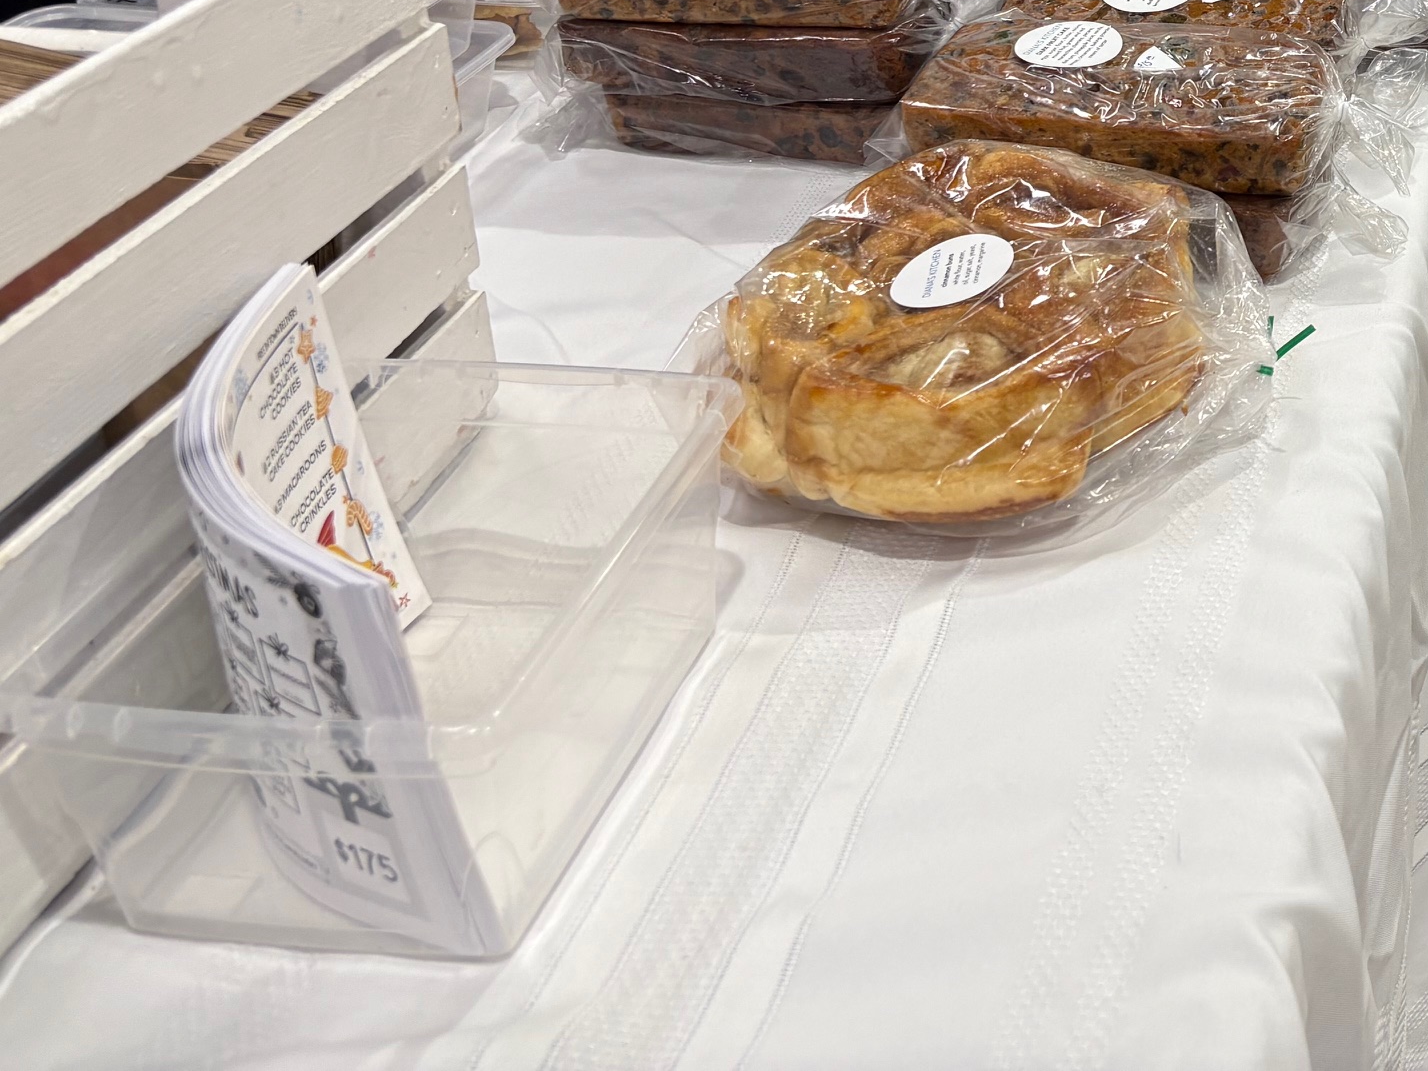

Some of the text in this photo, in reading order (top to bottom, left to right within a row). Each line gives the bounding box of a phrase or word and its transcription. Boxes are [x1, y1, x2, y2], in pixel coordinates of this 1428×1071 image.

[929, 248, 941, 275] KITCHEN
[941, 253, 954, 288] cinnamon buns
[278, 348, 296, 371] HOT
[258, 362, 299, 420] CHOCOLATE
[270, 377, 303, 421] COOKIES
[267, 413, 317, 483] CAKE COOKIES
[269, 415, 300, 460] RUSSIAN
[297, 400, 312, 420] TEA
[281, 439, 328, 503] MACAROONS
[289, 466, 335, 529] CHOCOLATE
[298, 482, 338, 534] CRINKLES
[334, 836, 398, 882] $175
